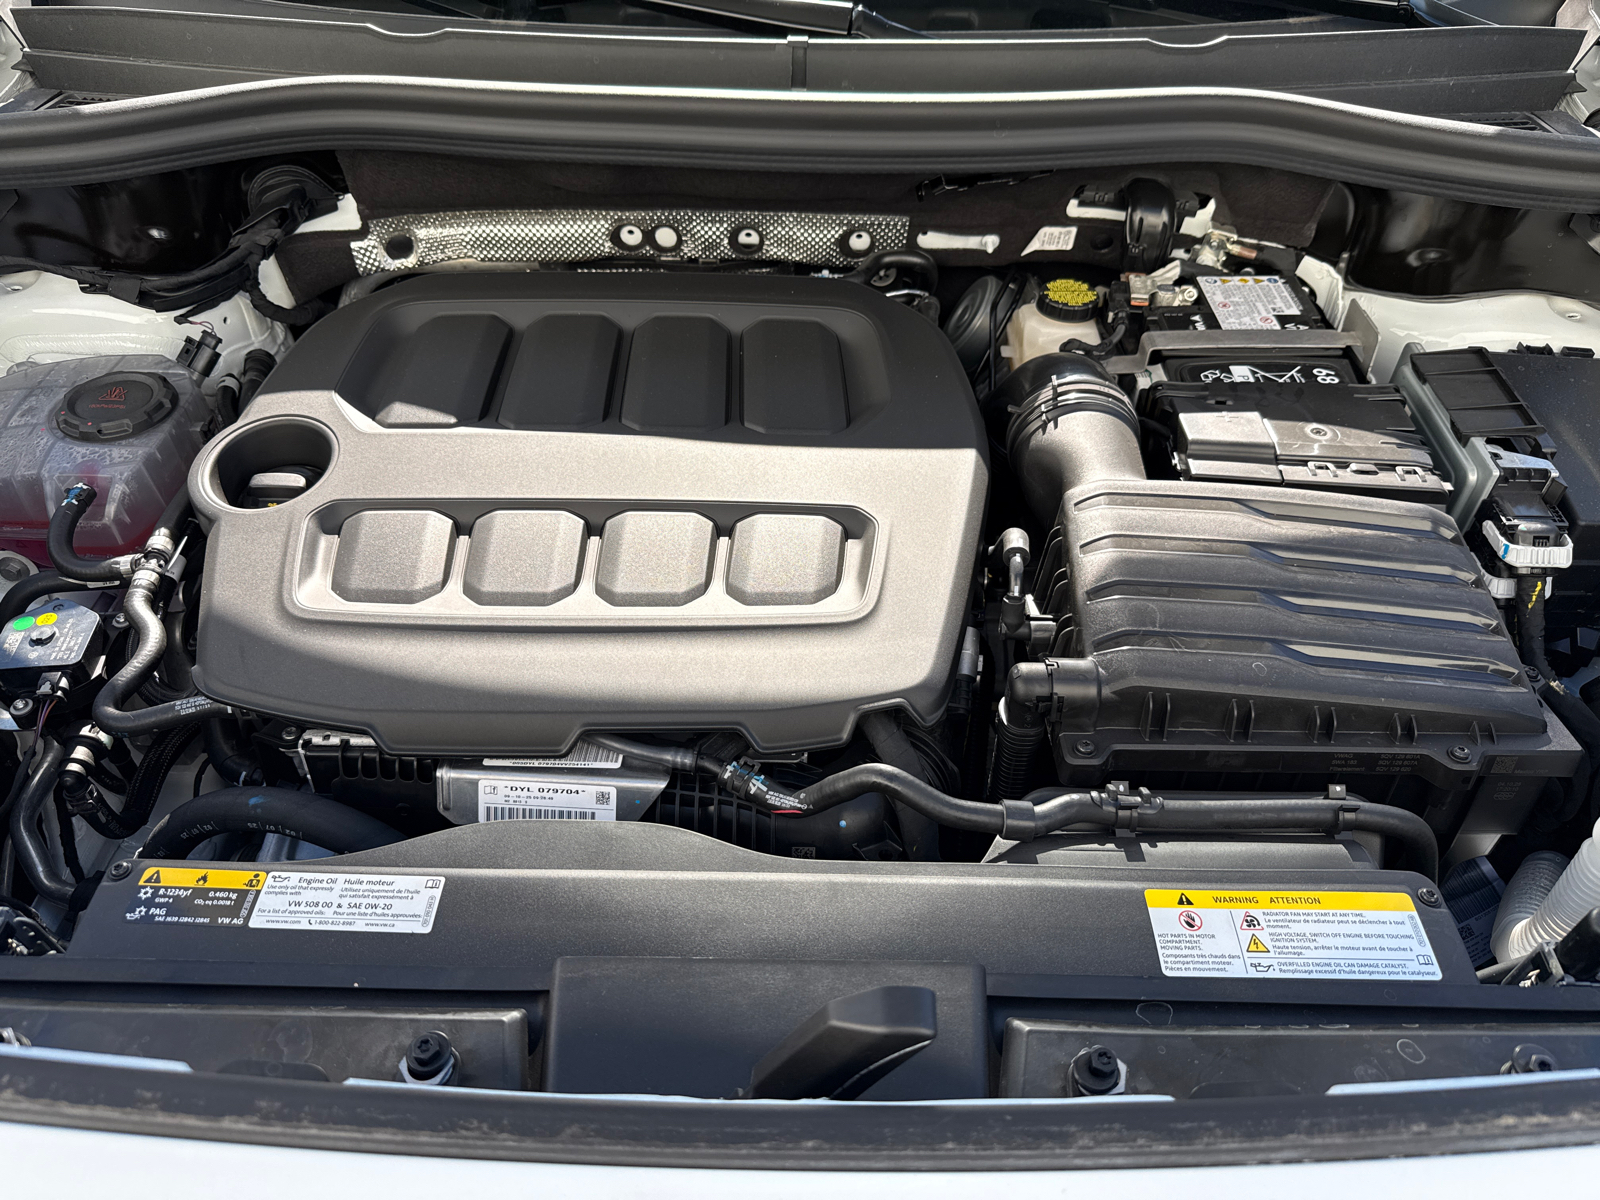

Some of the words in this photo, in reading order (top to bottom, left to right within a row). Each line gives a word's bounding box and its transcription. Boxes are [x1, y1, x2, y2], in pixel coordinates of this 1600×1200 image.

[297, 877, 324, 888] Engine
[158, 889, 193, 897] R-1234yf
[1162, 953, 1196, 961] Composants
